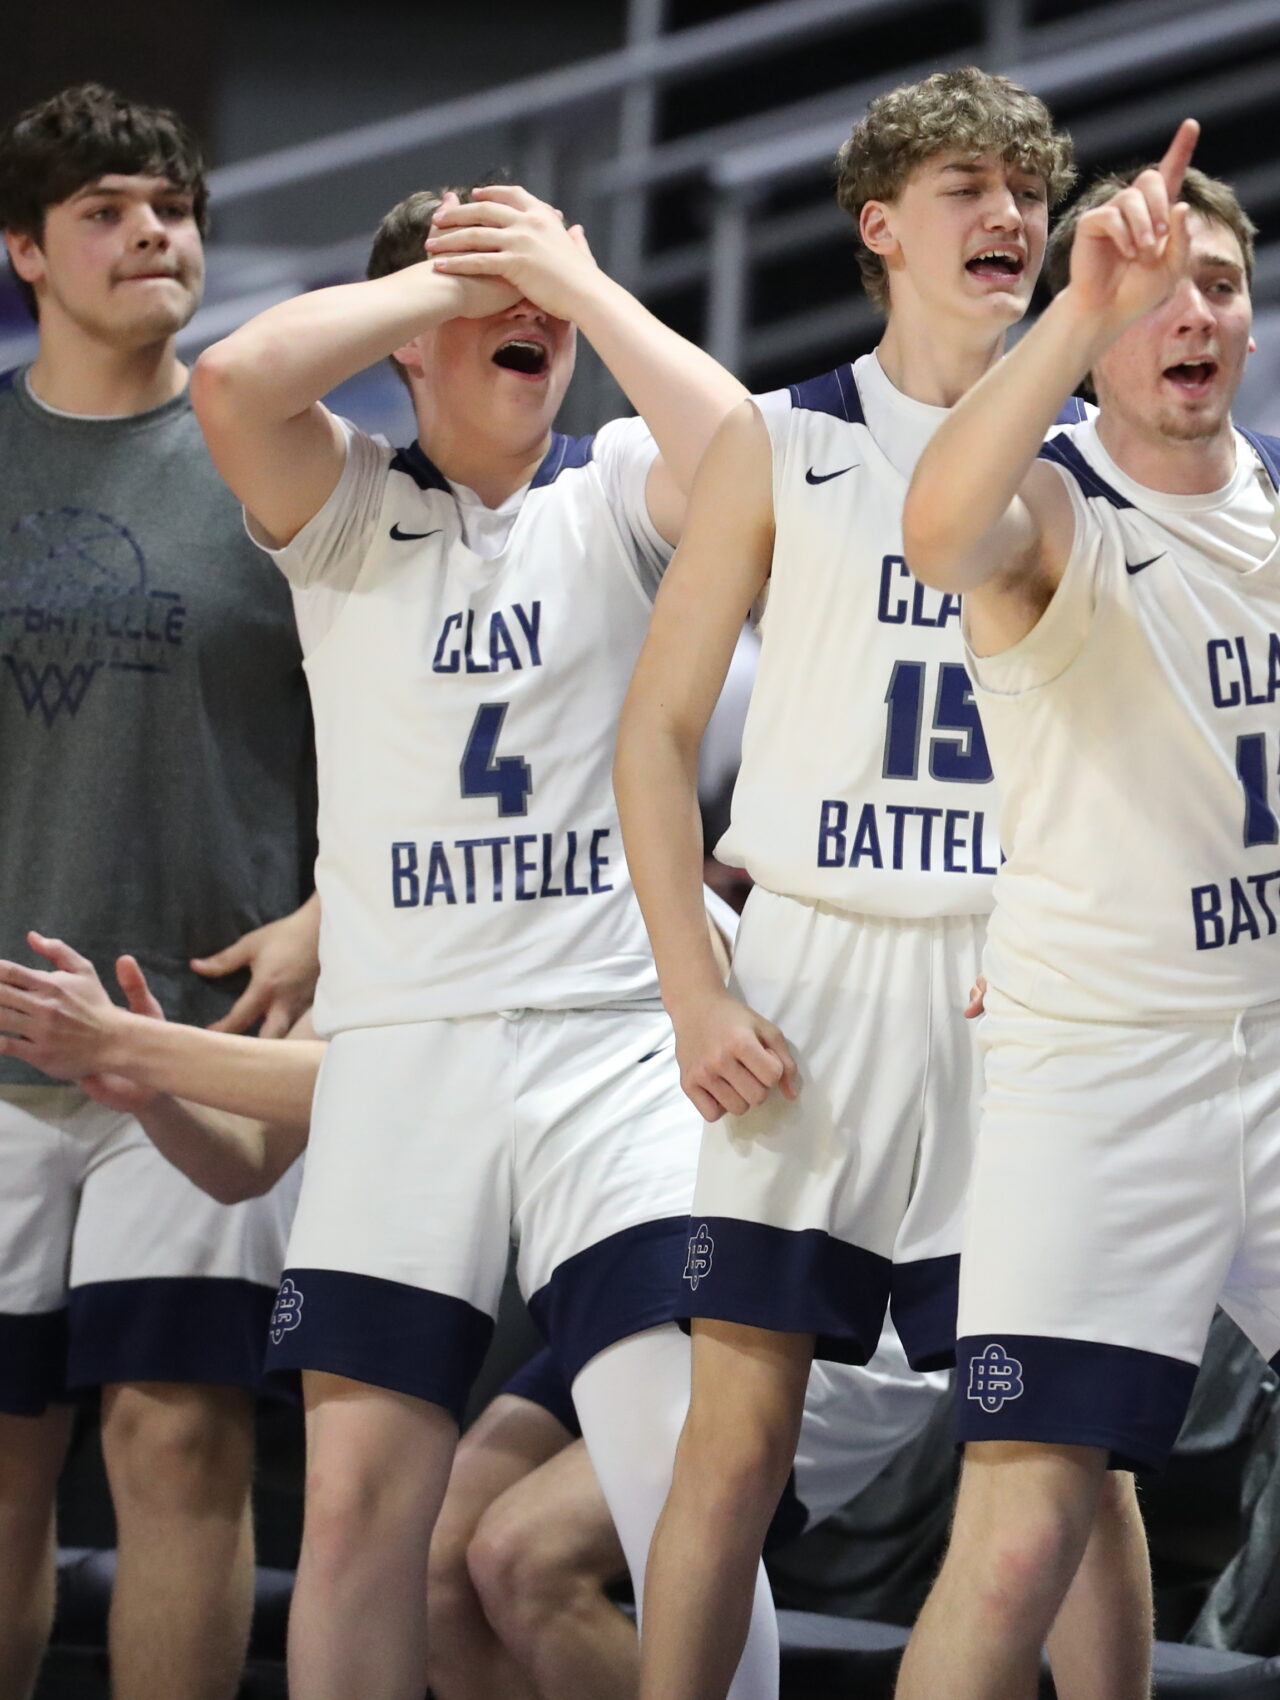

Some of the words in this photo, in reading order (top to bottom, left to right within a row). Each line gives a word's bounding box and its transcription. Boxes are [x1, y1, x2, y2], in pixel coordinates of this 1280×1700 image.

[432, 601, 542, 674] CLAY
[459, 702, 533, 818] 4
[882, 660, 995, 784] 15
[391, 828, 614, 908] BATTELLE
[817, 800, 1002, 876] BATTEL
